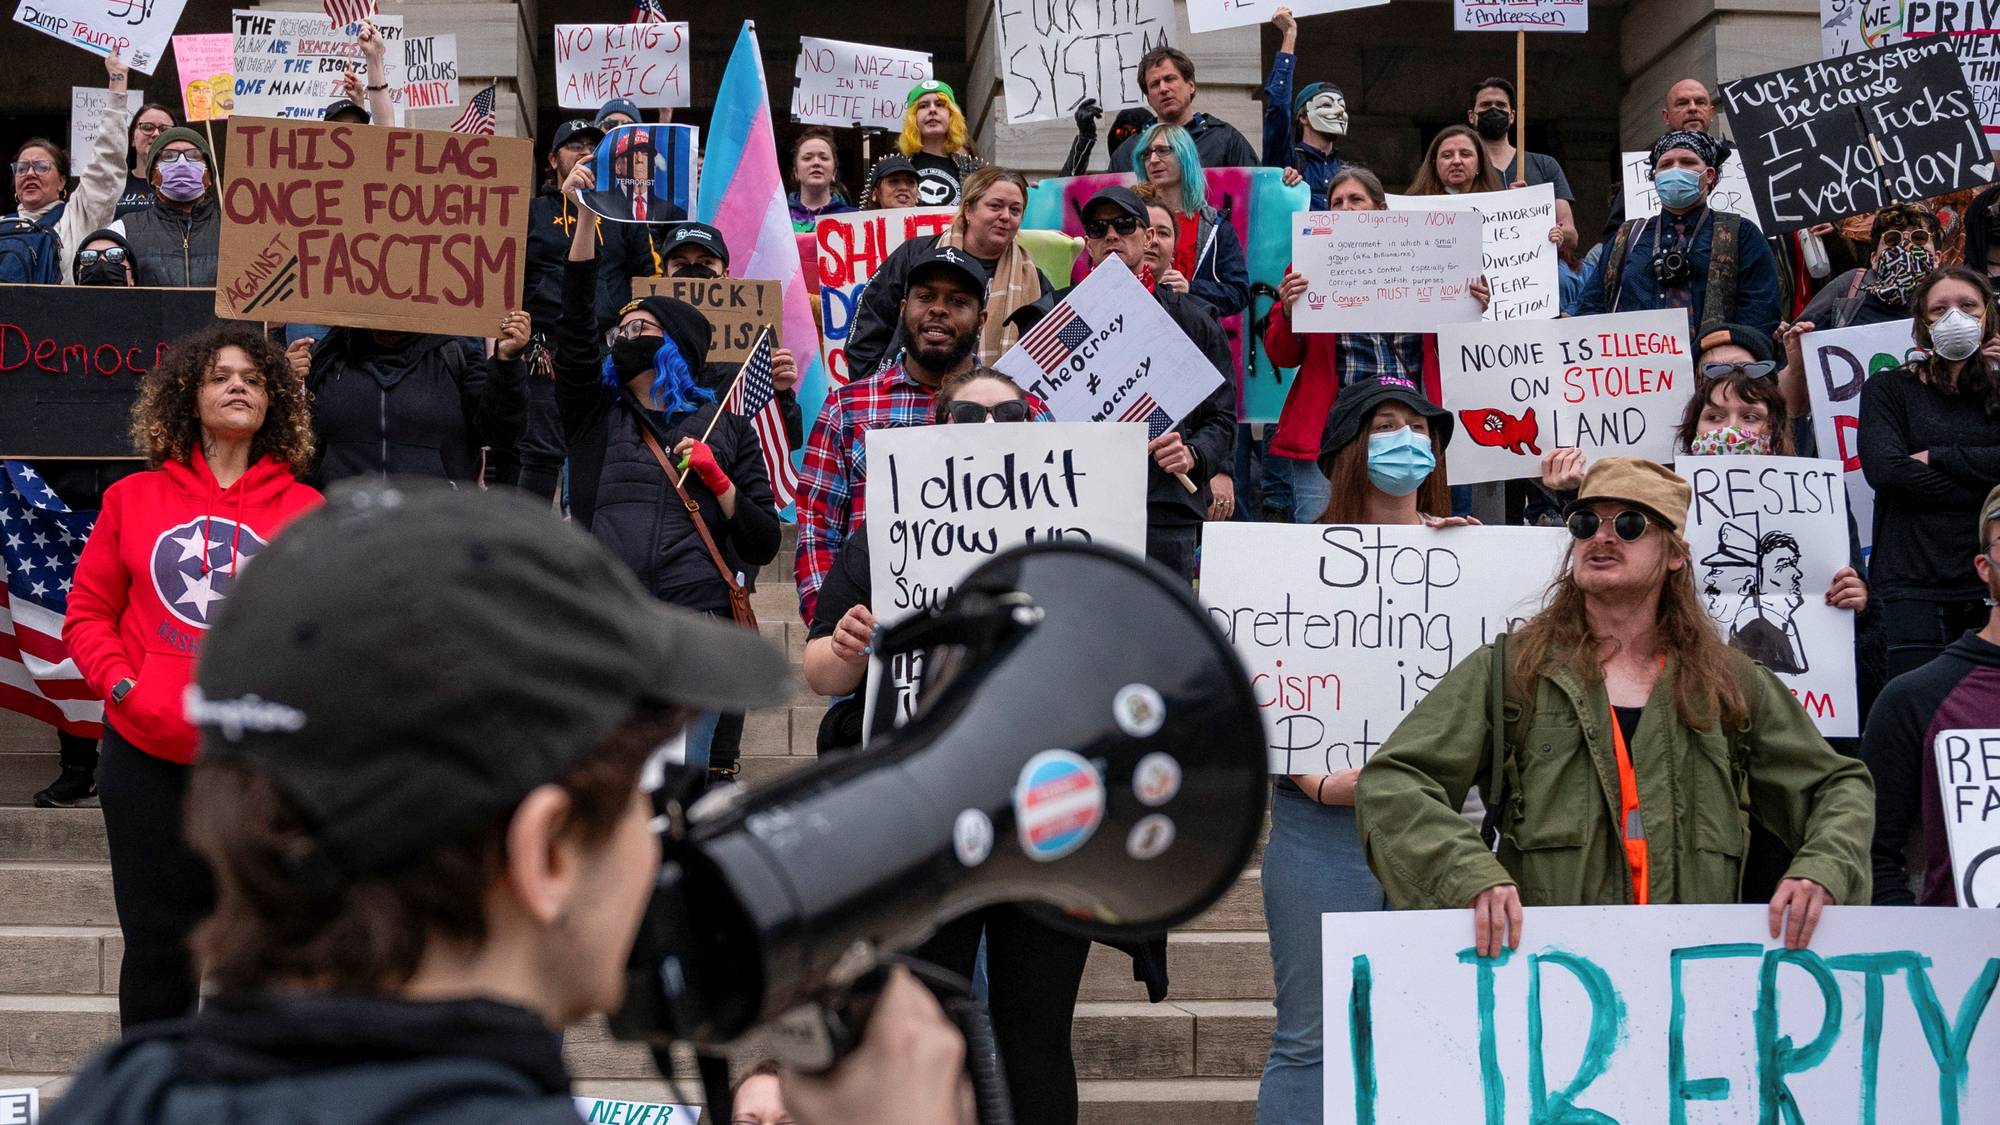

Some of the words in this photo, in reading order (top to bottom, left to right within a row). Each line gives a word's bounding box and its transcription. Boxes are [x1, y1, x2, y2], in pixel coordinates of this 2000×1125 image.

[1475, 8, 1565, 24] Andreessen
[1863, 6, 1891, 28] WE
[267, 39, 291, 53] ARE
[404, 36, 434, 66] RENT
[557, 27, 593, 64] NO
[605, 25, 682, 53] KINGS
[284, 59, 313, 73] THE
[407, 62, 457, 82] COLORS
[601, 54, 636, 70] IN
[804, 48, 836, 74] NO
[854, 54, 925, 81] NAZIS
[235, 79, 266, 95] ONE
[268, 80, 305, 95] MAN
[565, 64, 680, 102] AMERICA
[835, 77, 854, 89] IN
[858, 79, 880, 90] THE
[798, 93, 866, 120] WHITE
[871, 96, 906, 120] HOU
[1775, 76, 1902, 127] because
[236, 126, 355, 171] THIS
[386, 132, 499, 179] FLAG
[616, 178, 655, 187] TERRORIST
[224, 177, 345, 227] ONCE
[363, 182, 520, 228] FOUGHT
[1309, 214, 1340, 227] STOP
[1357, 213, 1409, 228] Oligarchy
[1424, 212, 1457, 227] NOW
[1328, 241, 1334, 249] a
[1338, 240, 1383, 251] government
[1400, 238, 1422, 247] which
[1434, 238, 1457, 247] small
[1482, 226, 1520, 244] IES
[226, 233, 294, 309] AGAINST
[299, 229, 518, 310] FASCISM
[1327, 254, 1350, 266] group
[1330, 268, 1373, 276] exercises
[1377, 266, 1402, 274] control
[1482, 244, 1541, 270] DIVISION
[1307, 291, 1327, 304] Our
[1332, 291, 1371, 304] Congress
[1376, 286, 1410, 301] MUST
[1416, 286, 1434, 297] ACT
[1328, 279, 1357, 288] corrupt
[1384, 276, 1408, 285] selfish
[1490, 276, 1539, 296] FEAR
[1494, 294, 1550, 321] FICTION
[0, 323, 176, 377] Democr
[709, 322, 780, 350] CISM
[1562, 338, 1593, 365] IS
[1599, 332, 1684, 358] ILLEGAL
[1087, 356, 1152, 423] mocracy
[1511, 376, 1549, 402] ON
[1563, 366, 1674, 404] STOLEN
[1554, 407, 1647, 450] LAND
[889, 454, 899, 515] I
[920, 449, 1087, 513] didn't
[1694, 466, 1838, 527] RESIST
[890, 518, 998, 577] grow
[1319, 526, 1460, 613] Stop
[157, 620, 206, 657] NASH
[1251, 660, 1342, 712] cism
[1269, 715, 1385, 776] Pat
[588, 1100, 674, 1125] NEVER
